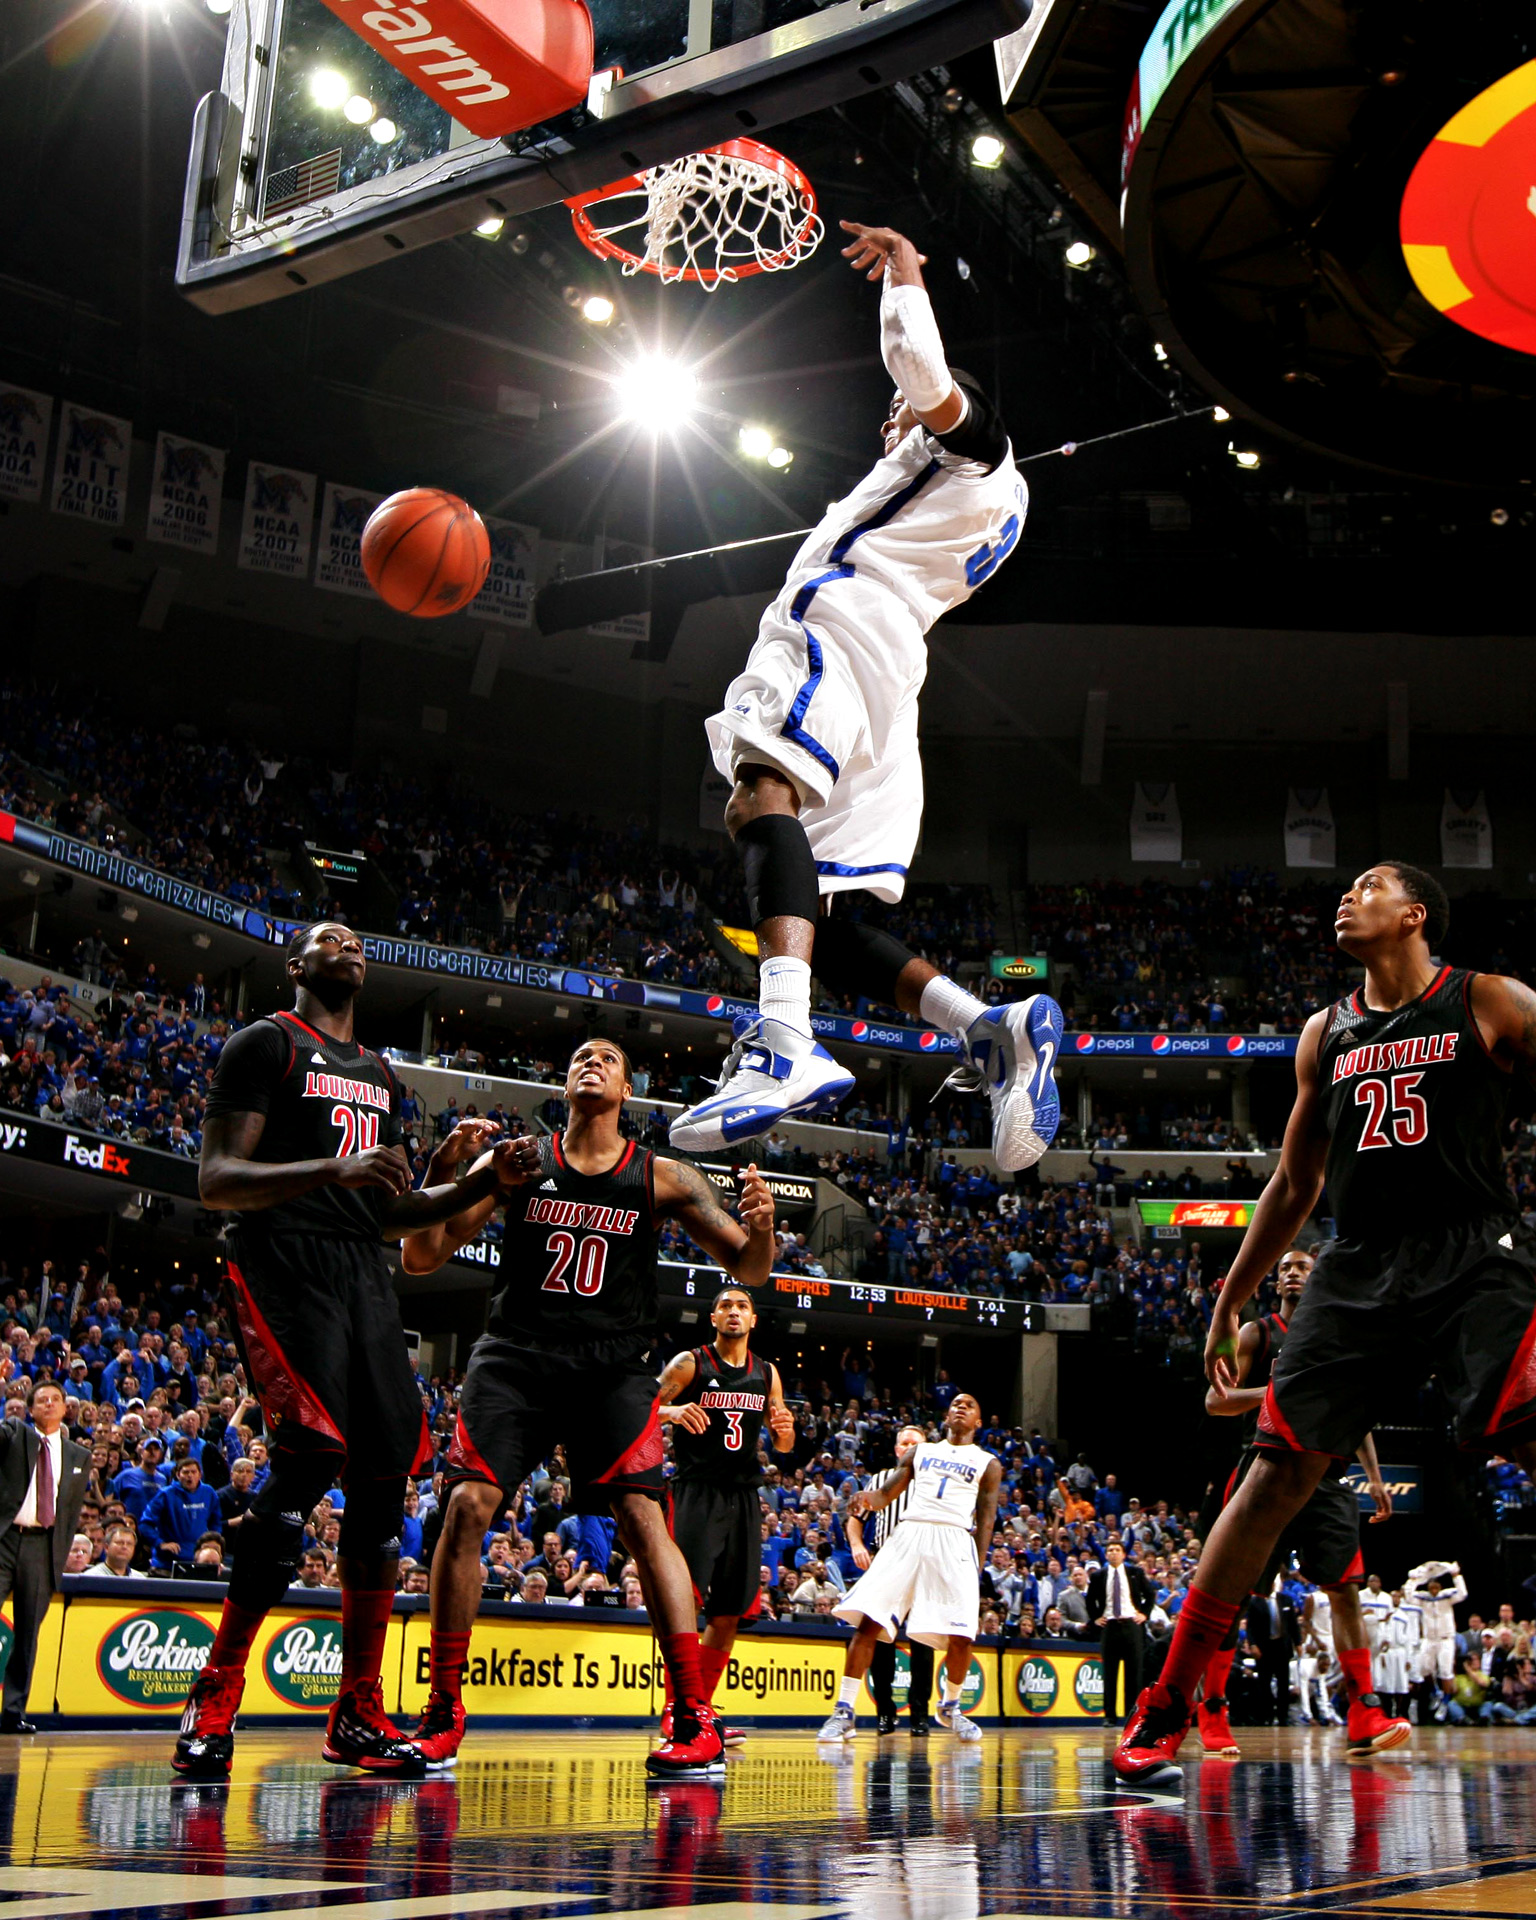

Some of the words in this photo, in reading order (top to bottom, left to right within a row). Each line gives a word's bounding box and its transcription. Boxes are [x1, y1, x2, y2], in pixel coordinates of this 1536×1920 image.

[362, 0, 510, 105] arm
[0, 434, 36, 458] CAA
[64, 453, 120, 488] NIT
[61, 478, 119, 509] 2005
[163, 485, 209, 510] NCAA
[57, 497, 87, 515] FINAL
[91, 504, 119, 523] FOUR
[163, 502, 207, 527] 2006
[254, 514, 300, 537] NCAA
[254, 533, 298, 554] 2007
[330, 534, 362, 551] NCA
[330, 551, 361, 569] 200
[481, 579, 521, 599] 2011
[48, 834, 137, 888] MEMPHIS
[142, 872, 233, 924] GRIZZLIES
[363, 938, 439, 969] EMPHIS
[447, 951, 549, 988] GRIZZLIES
[725, 1003, 760, 1016] peps
[811, 1018, 836, 1032] epsi
[869, 1028, 904, 1044] pepsi
[1096, 1037, 1135, 1051] pepsi
[1172, 1038, 1210, 1051] pepsi
[1247, 1039, 1286, 1053] pepsi
[1332, 1032, 1460, 1086] LOUISVILLE
[301, 1071, 391, 1115] LOUISVILLE
[1354, 1071, 1429, 1153] 25
[64, 1134, 131, 1177] FedEx
[523, 1197, 640, 1236] LOUISVILLE
[1177, 1210, 1230, 1224] SOUTHLAND
[1201, 1217, 1227, 1226] PARK
[1157, 1227, 1180, 1238] 103A
[454, 1242, 487, 1263] ted
[490, 1244, 501, 1267] b
[540, 1230, 609, 1297] 20
[688, 1268, 696, 1279] F
[776, 1277, 831, 1296] MEMPHIS
[850, 1286, 887, 1303] 12:53
[895, 1290, 968, 1311] LOUISVILLE
[977, 1300, 1006, 1313] T.O.L
[1024, 1303, 1031, 1315] F
[686, 1281, 695, 1296] 6
[797, 1295, 812, 1309] 16
[925, 1307, 935, 1321] 7
[988, 1313, 998, 1327] 4
[1023, 1315, 1031, 1330] 4
[700, 1391, 766, 1412] LOUISVILLE
[723, 1411, 744, 1451] 3
[919, 1456, 977, 1484] MEMPHIS
[936, 1475, 949, 1500] 1
[109, 1619, 211, 1672] Perkins
[273, 1626, 343, 1675] Perkin
[128, 1668, 194, 1682] RESTAURANT
[290, 1672, 342, 1685] RESTAURAN
[573, 1652, 600, 1689] Is
[607, 1654, 665, 1690] Just
[726, 1657, 836, 1701] Beginning
[1018, 1662, 1055, 1694] Perkins
